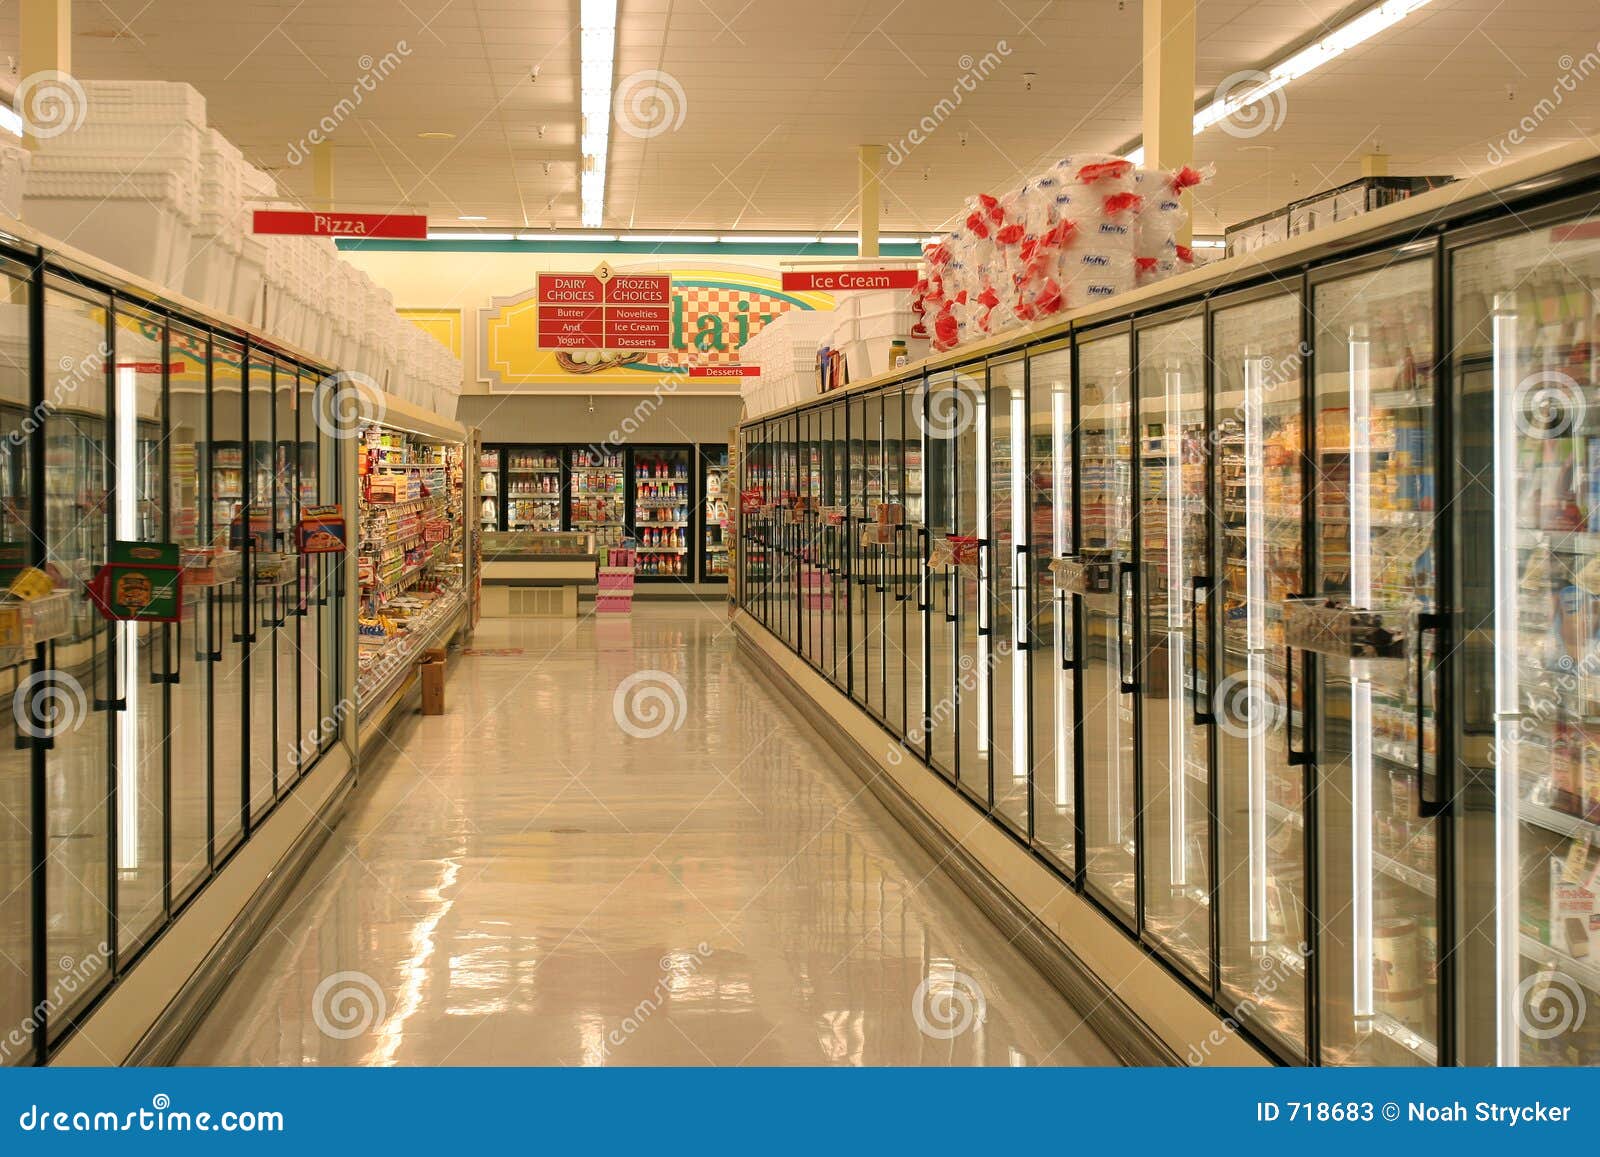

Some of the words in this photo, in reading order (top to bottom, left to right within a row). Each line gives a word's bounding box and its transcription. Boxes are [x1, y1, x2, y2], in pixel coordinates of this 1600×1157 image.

[314, 215, 366, 234] Pizza
[600, 267, 609, 279] 3
[555, 279, 586, 289] DAIRY
[616, 280, 659, 290] FROZEN
[810, 275, 834, 288] Ice
[838, 274, 890, 288] Cream
[547, 290, 595, 301] CHOICES
[1088, 286, 1114, 295] Hefty
[613, 291, 662, 301] CHOICES
[557, 308, 585, 317] Butter
[616, 310, 658, 318] Novelties
[562, 323, 580, 331] And
[615, 323, 628, 331] Ice
[630, 323, 659, 331] Cream
[556, 336, 585, 346] Yogurt
[618, 338, 656, 346] Desserts
[706, 368, 744, 376] Desserts
